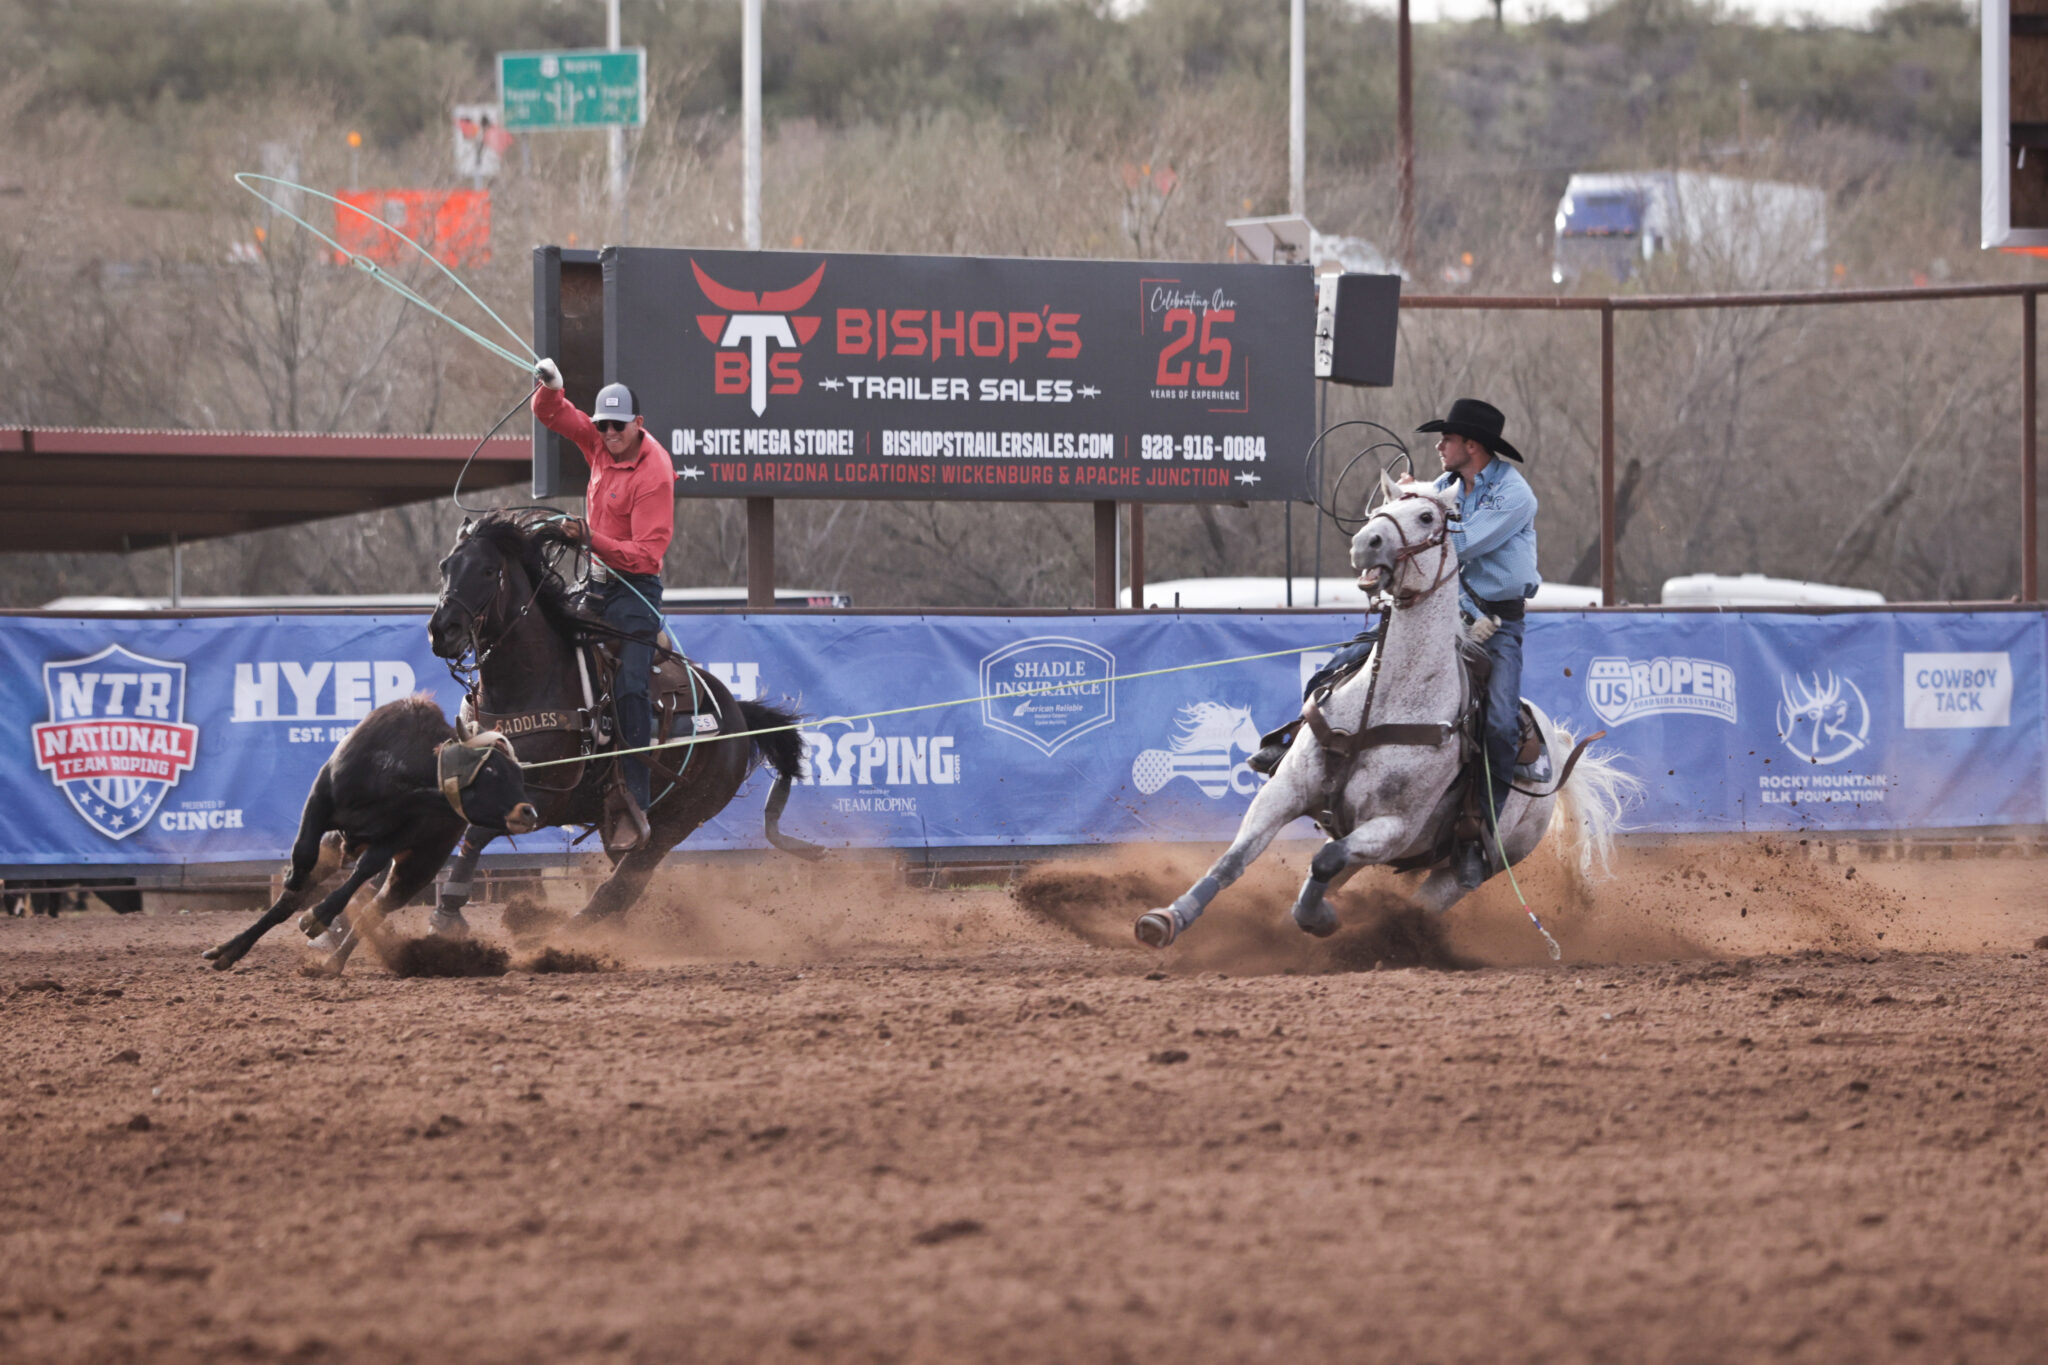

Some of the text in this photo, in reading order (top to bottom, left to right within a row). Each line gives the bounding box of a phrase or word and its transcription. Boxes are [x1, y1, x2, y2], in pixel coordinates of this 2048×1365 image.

[1151, 286, 1237, 317] Celebrating Over
[836, 304, 1083, 364] BISHOP'S
[1156, 309, 1235, 386] 25
[846, 376, 1074, 402] TRAILER SALES
[1150, 389, 1240, 400] YEARS OF EXPERIENCE
[671, 429, 854, 456] ON-SITE MEGA STORE!
[882, 430, 1114, 459] BISHOPSTRAILERSALES.COM
[1141, 434, 1266, 461] 928-916-0084
[710, 463, 1230, 487] TWO ARIZONA LOCATIONS! WICKENBURG & APACHE JUNCTION
[1014, 661, 1086, 678] SHADLE
[1916, 668, 1998, 689] COWBOY
[995, 680, 1101, 697] INSURANCE
[1631, 660, 1733, 703] ROPER
[58, 672, 172, 718] NTR
[1595, 683, 1628, 706] US
[1677, 696, 1732, 713] ASSISTANCE
[1935, 692, 1983, 712] TACK
[289, 726, 325, 743] EST.
[496, 712, 558, 735] SADDLES
[42, 726, 186, 758] NATIONAL
[60, 756, 170, 775] TEAM ROPING
[1759, 774, 1887, 788] ROCKY MOUNTAIN
[838, 798, 871, 812] TEAM
[874, 797, 916, 812] ROPING
[1761, 789, 1884, 803] ELK FOUNDATION
[159, 809, 244, 831] CINCH
